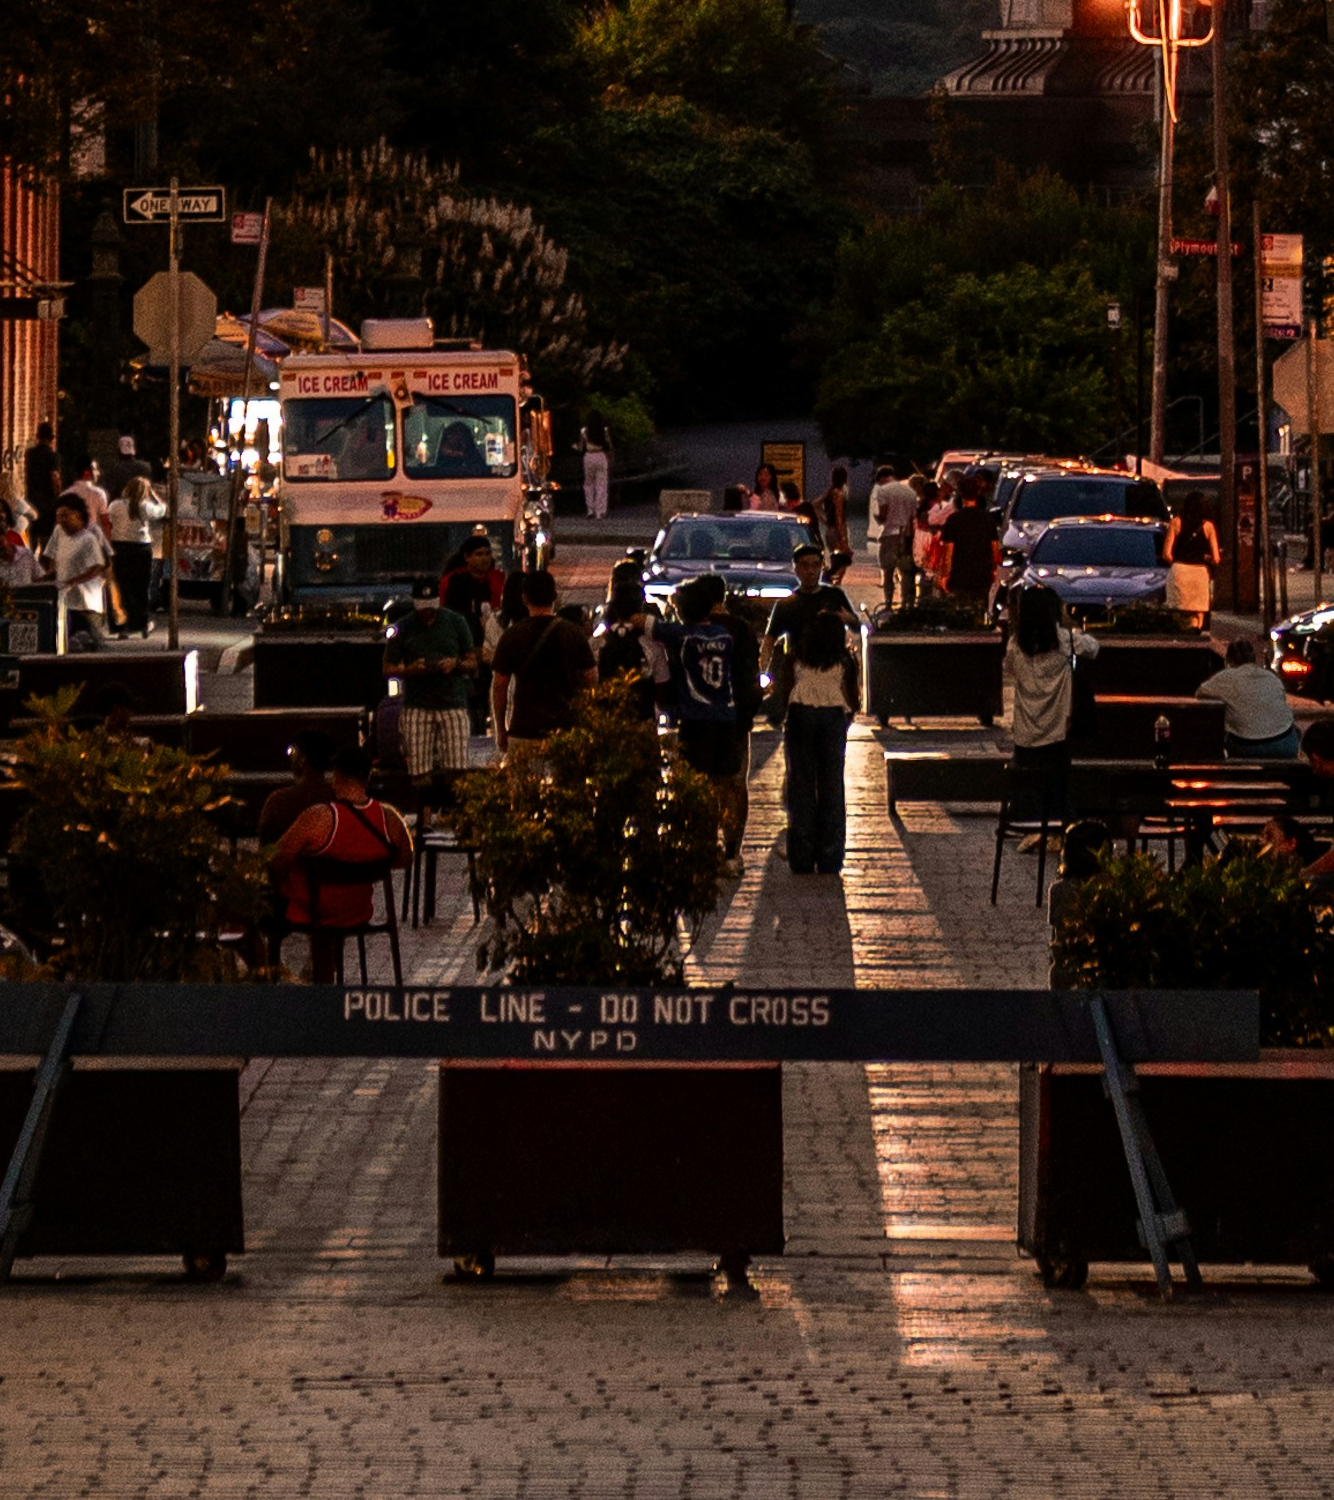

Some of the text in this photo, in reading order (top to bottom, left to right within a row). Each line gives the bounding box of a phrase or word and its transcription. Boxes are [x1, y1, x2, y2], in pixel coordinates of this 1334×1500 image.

[139, 198, 210, 212] ONE WAY
[298, 375, 369, 392] ICE CREAM
[428, 373, 499, 390] ICE CREAM
[698, 655, 725, 690] 10
[343, 990, 451, 1023] POLICE
[479, 991, 547, 1024] LINE
[599, 993, 640, 1025] DO
[653, 994, 716, 1026] NOT
[728, 995, 832, 1027] CROSS
[532, 1028, 637, 1051] NYPD
